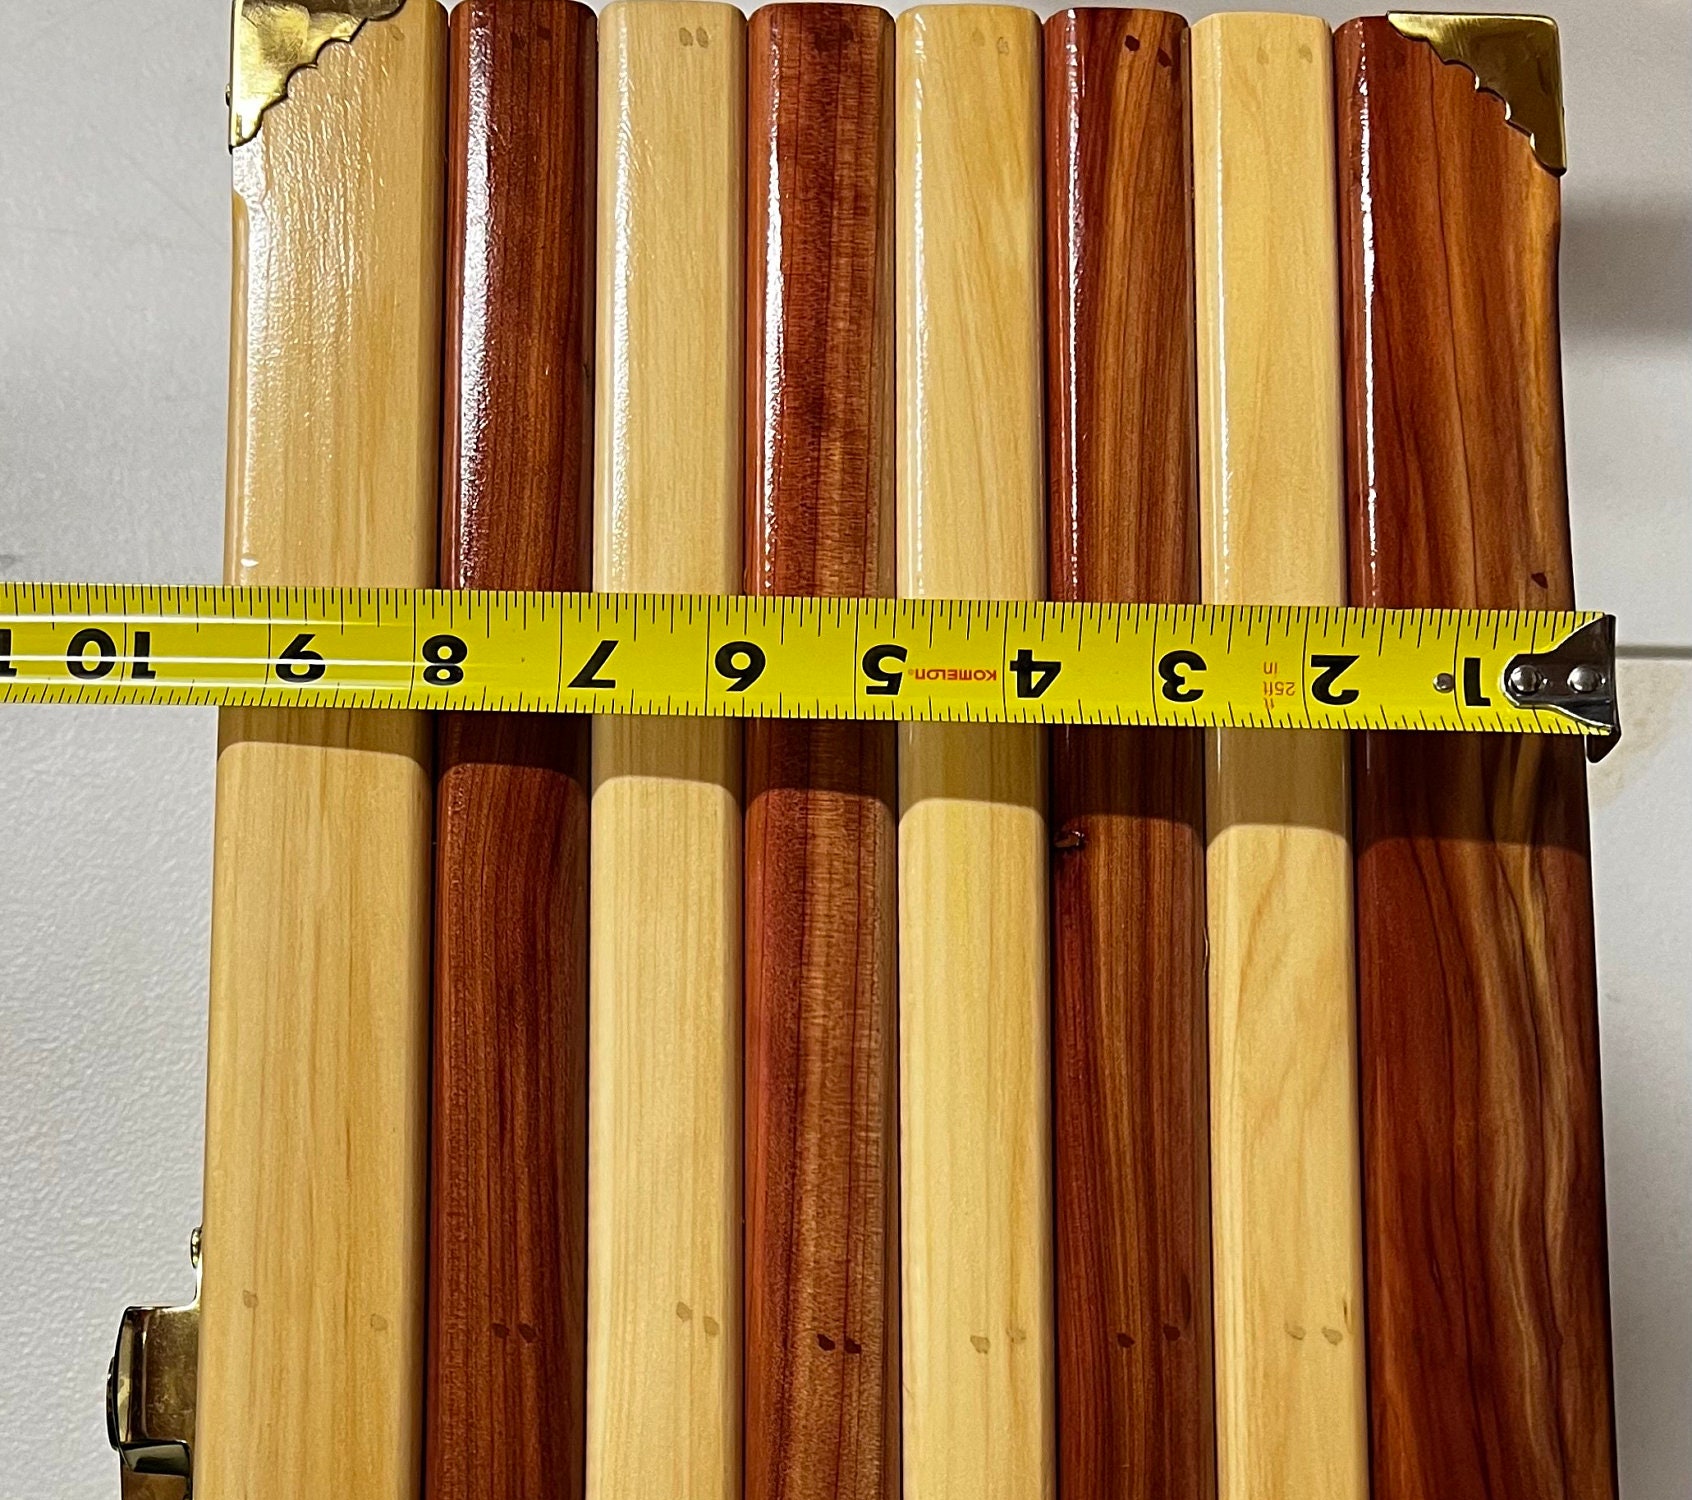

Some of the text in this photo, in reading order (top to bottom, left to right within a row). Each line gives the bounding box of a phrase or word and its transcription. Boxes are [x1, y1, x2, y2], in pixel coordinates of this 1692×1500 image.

[66, 627, 157, 680] 10
[275, 633, 326, 683] 9
[422, 634, 468, 686] 8
[567, 639, 619, 689] 7
[714, 640, 766, 692] 6
[861, 644, 908, 696] 5
[1009, 649, 1062, 699] 4
[1158, 649, 1207, 703] 3
[1263, 661, 1278, 675] in
[1262, 681, 1296, 697] 25ft
[1310, 654, 1360, 706] 2
[1463, 657, 1491, 707] 1
